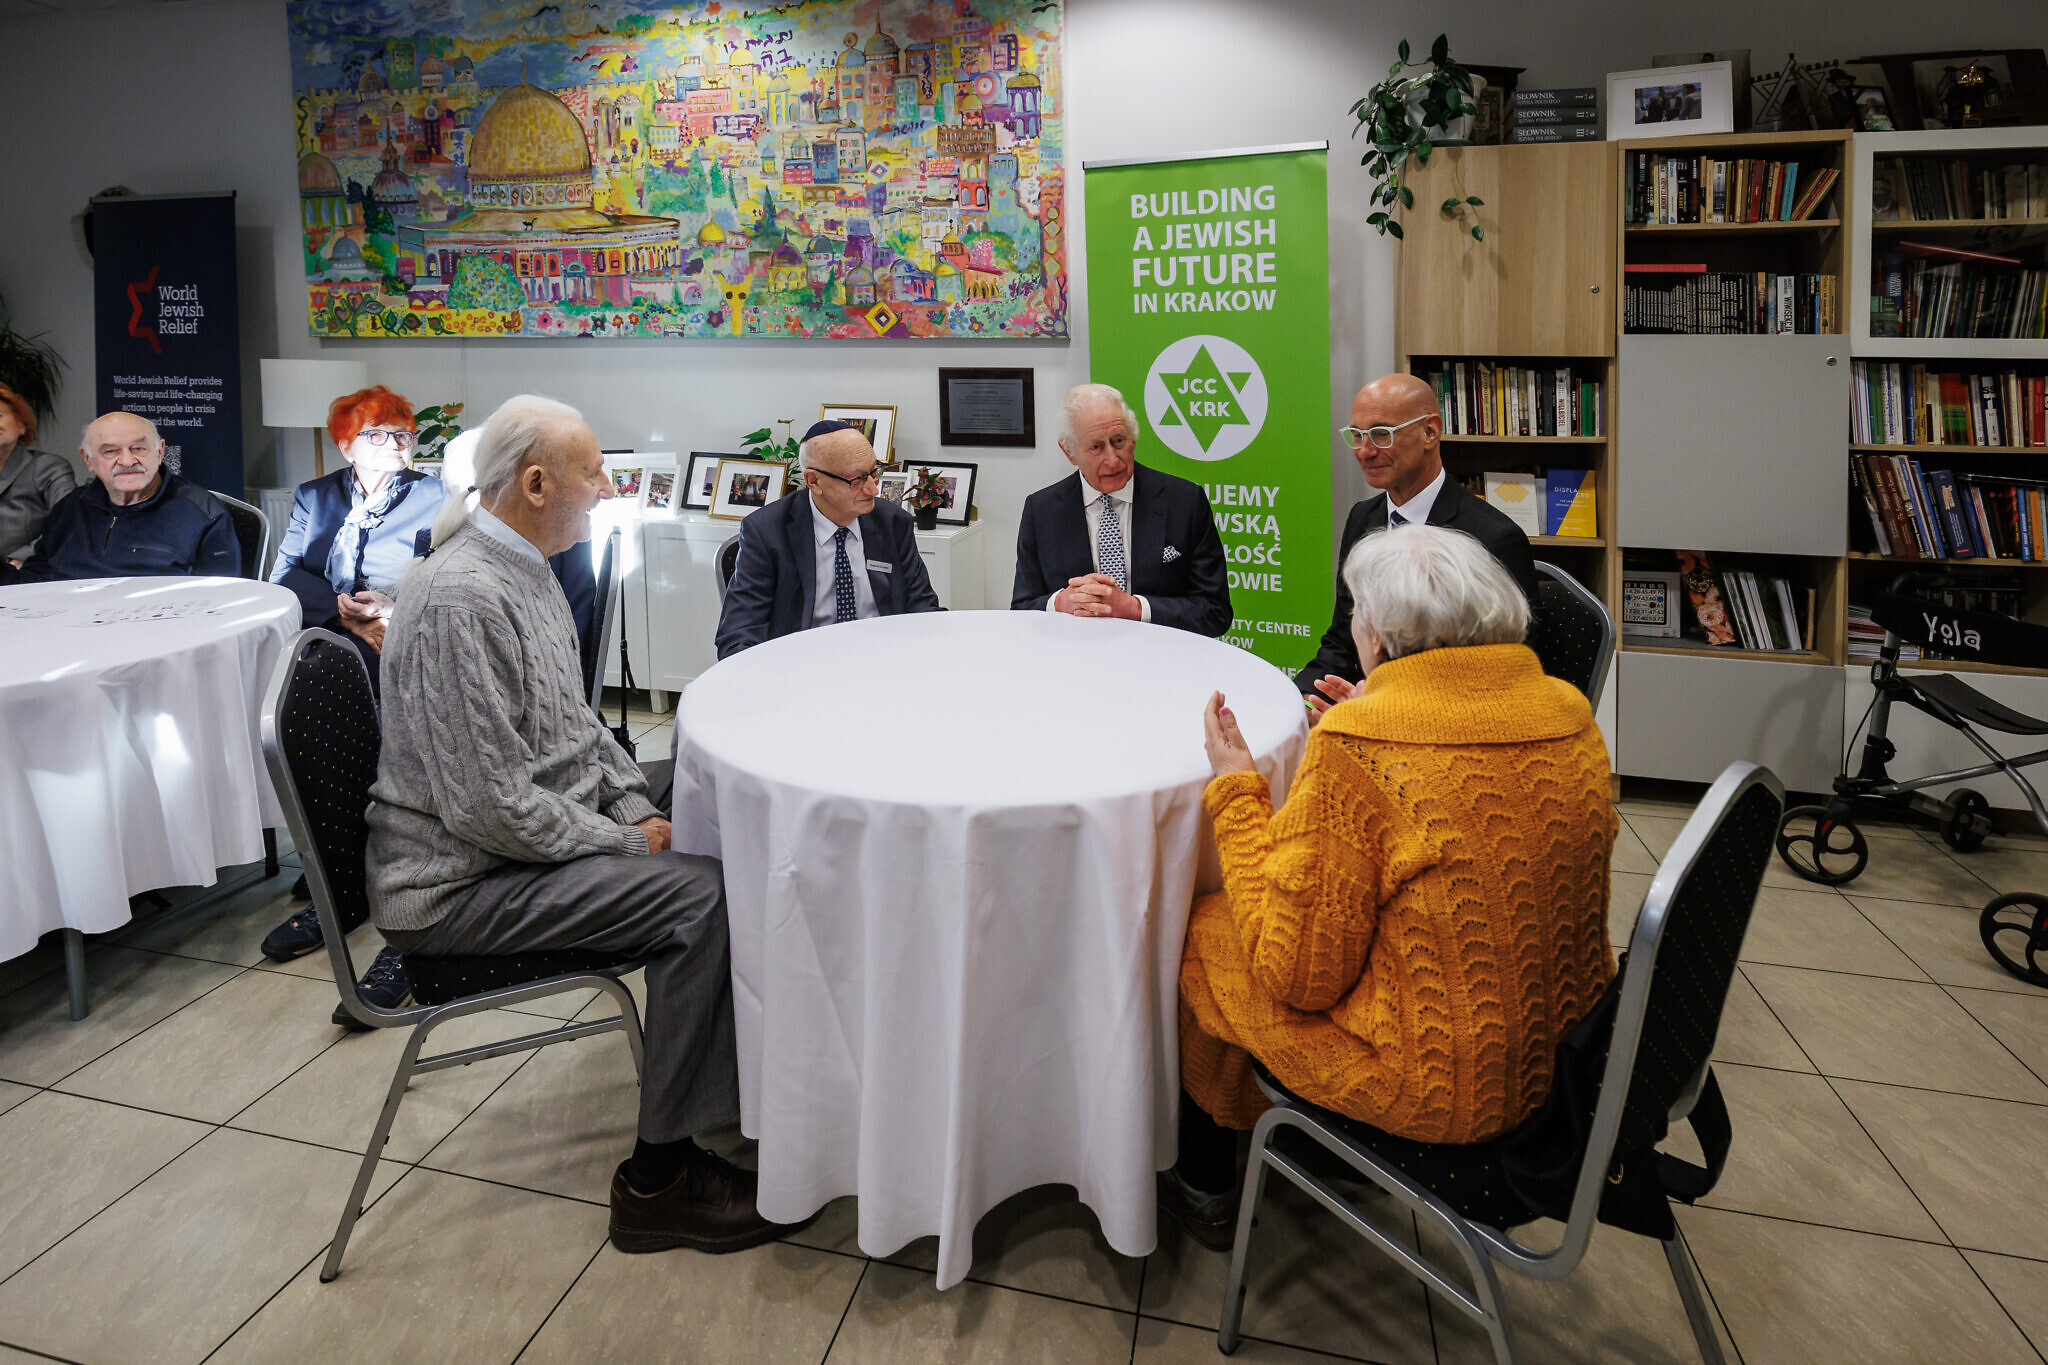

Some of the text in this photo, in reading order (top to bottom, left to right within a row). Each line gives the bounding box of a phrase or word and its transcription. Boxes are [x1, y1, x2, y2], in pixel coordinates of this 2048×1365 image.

[1516, 92, 1556, 100] SŁOWNIK
[1518, 110, 1556, 118] SŁOWNIK
[1518, 128, 1556, 136] SŁOWNIK
[1130, 185, 1276, 219] BUILDING
[1133, 219, 1276, 251] A JEWISH
[1132, 252, 1277, 288] FUTURE
[158, 285, 198, 300] World
[159, 301, 204, 317] Jewish
[1134, 289, 1277, 314] IN KRAKOW
[158, 319, 198, 334] Relief
[113, 375, 222, 386] World Jewish Relief provides
[1177, 378, 1217, 394] JCC
[113, 388, 222, 401] life-saving and life-changing
[122, 403, 216, 414] action to people in crisis
[1189, 401, 1231, 417] KRK
[163, 418, 176, 426] the
[177, 417, 204, 427] world.
[1205, 483, 1280, 508] JEMY
[1215, 512, 1281, 541] WSKĄ
[1223, 542, 1282, 566] ŁOŚĆ
[1227, 570, 1283, 592] OWIE
[1231, 618, 1311, 637] ITY CENTRE
[1923, 612, 1981, 652] Yola
[1221, 635, 1254, 649] KOW
